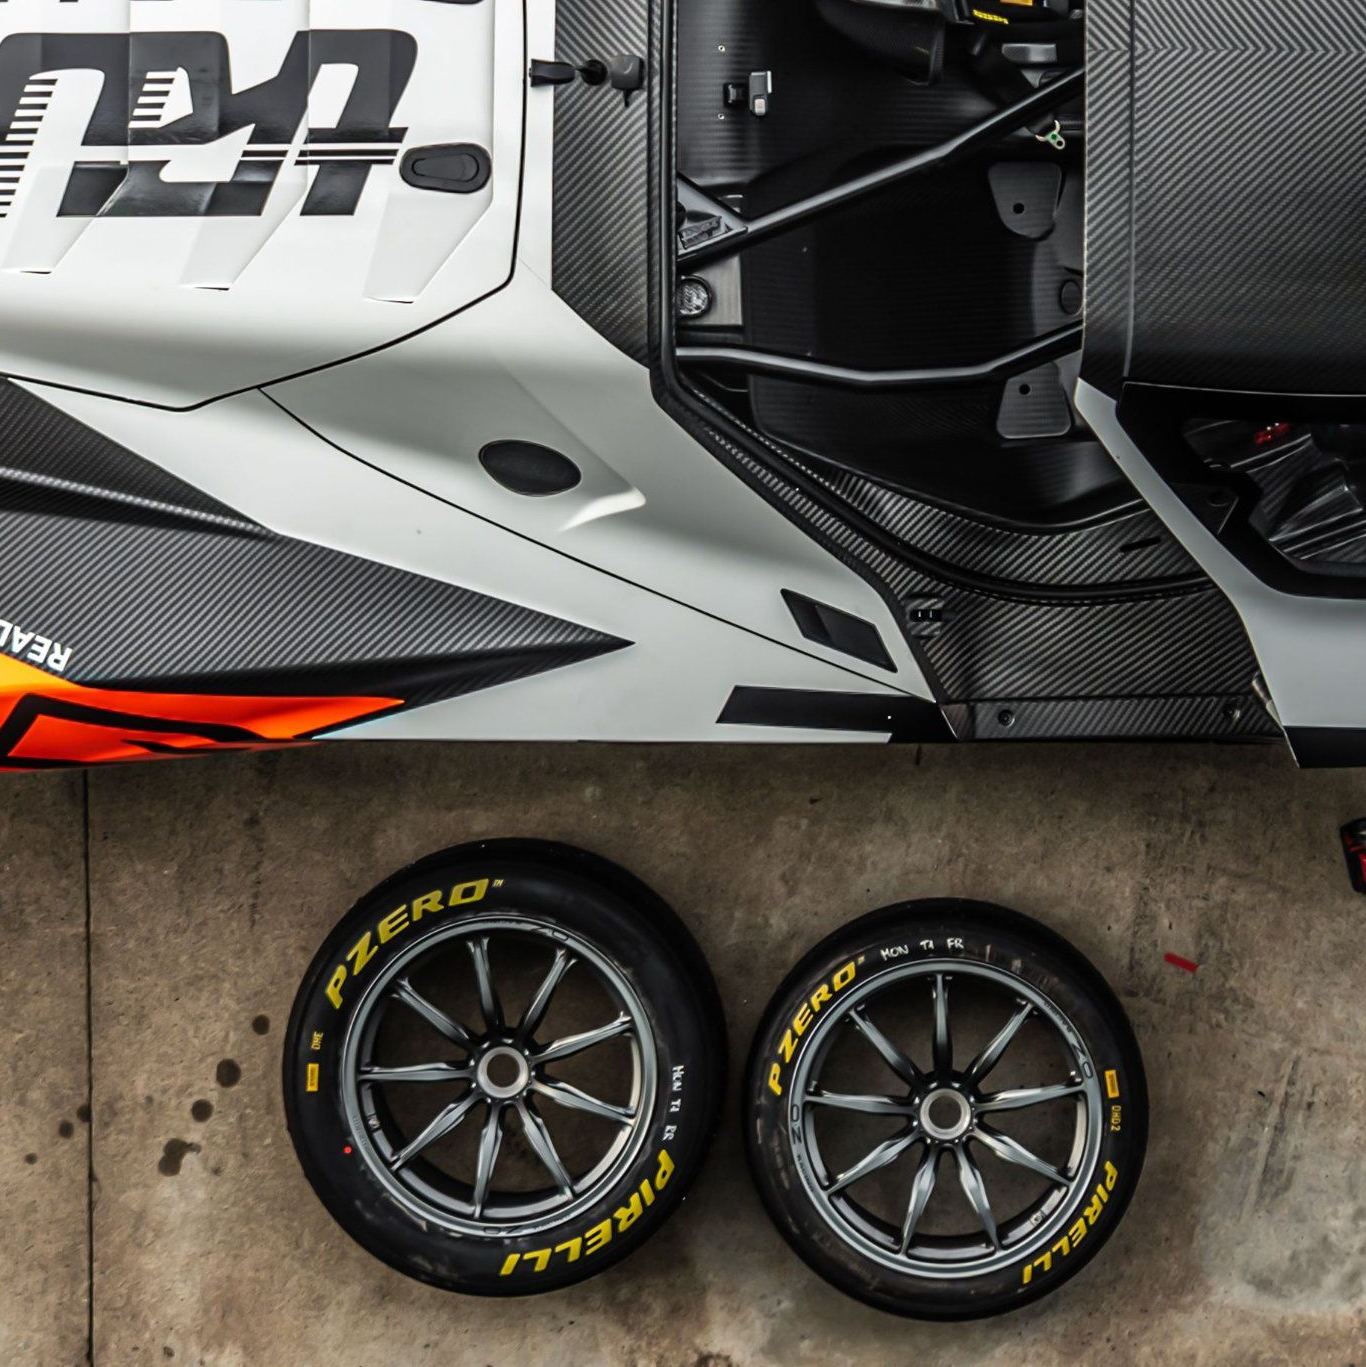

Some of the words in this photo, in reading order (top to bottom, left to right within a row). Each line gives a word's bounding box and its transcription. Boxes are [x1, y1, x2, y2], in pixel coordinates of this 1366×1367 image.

[946, 936, 965, 951] FR
[498, 1148, 676, 1277] PIRELLI
[1021, 1160, 1119, 1286] PIRELLI
